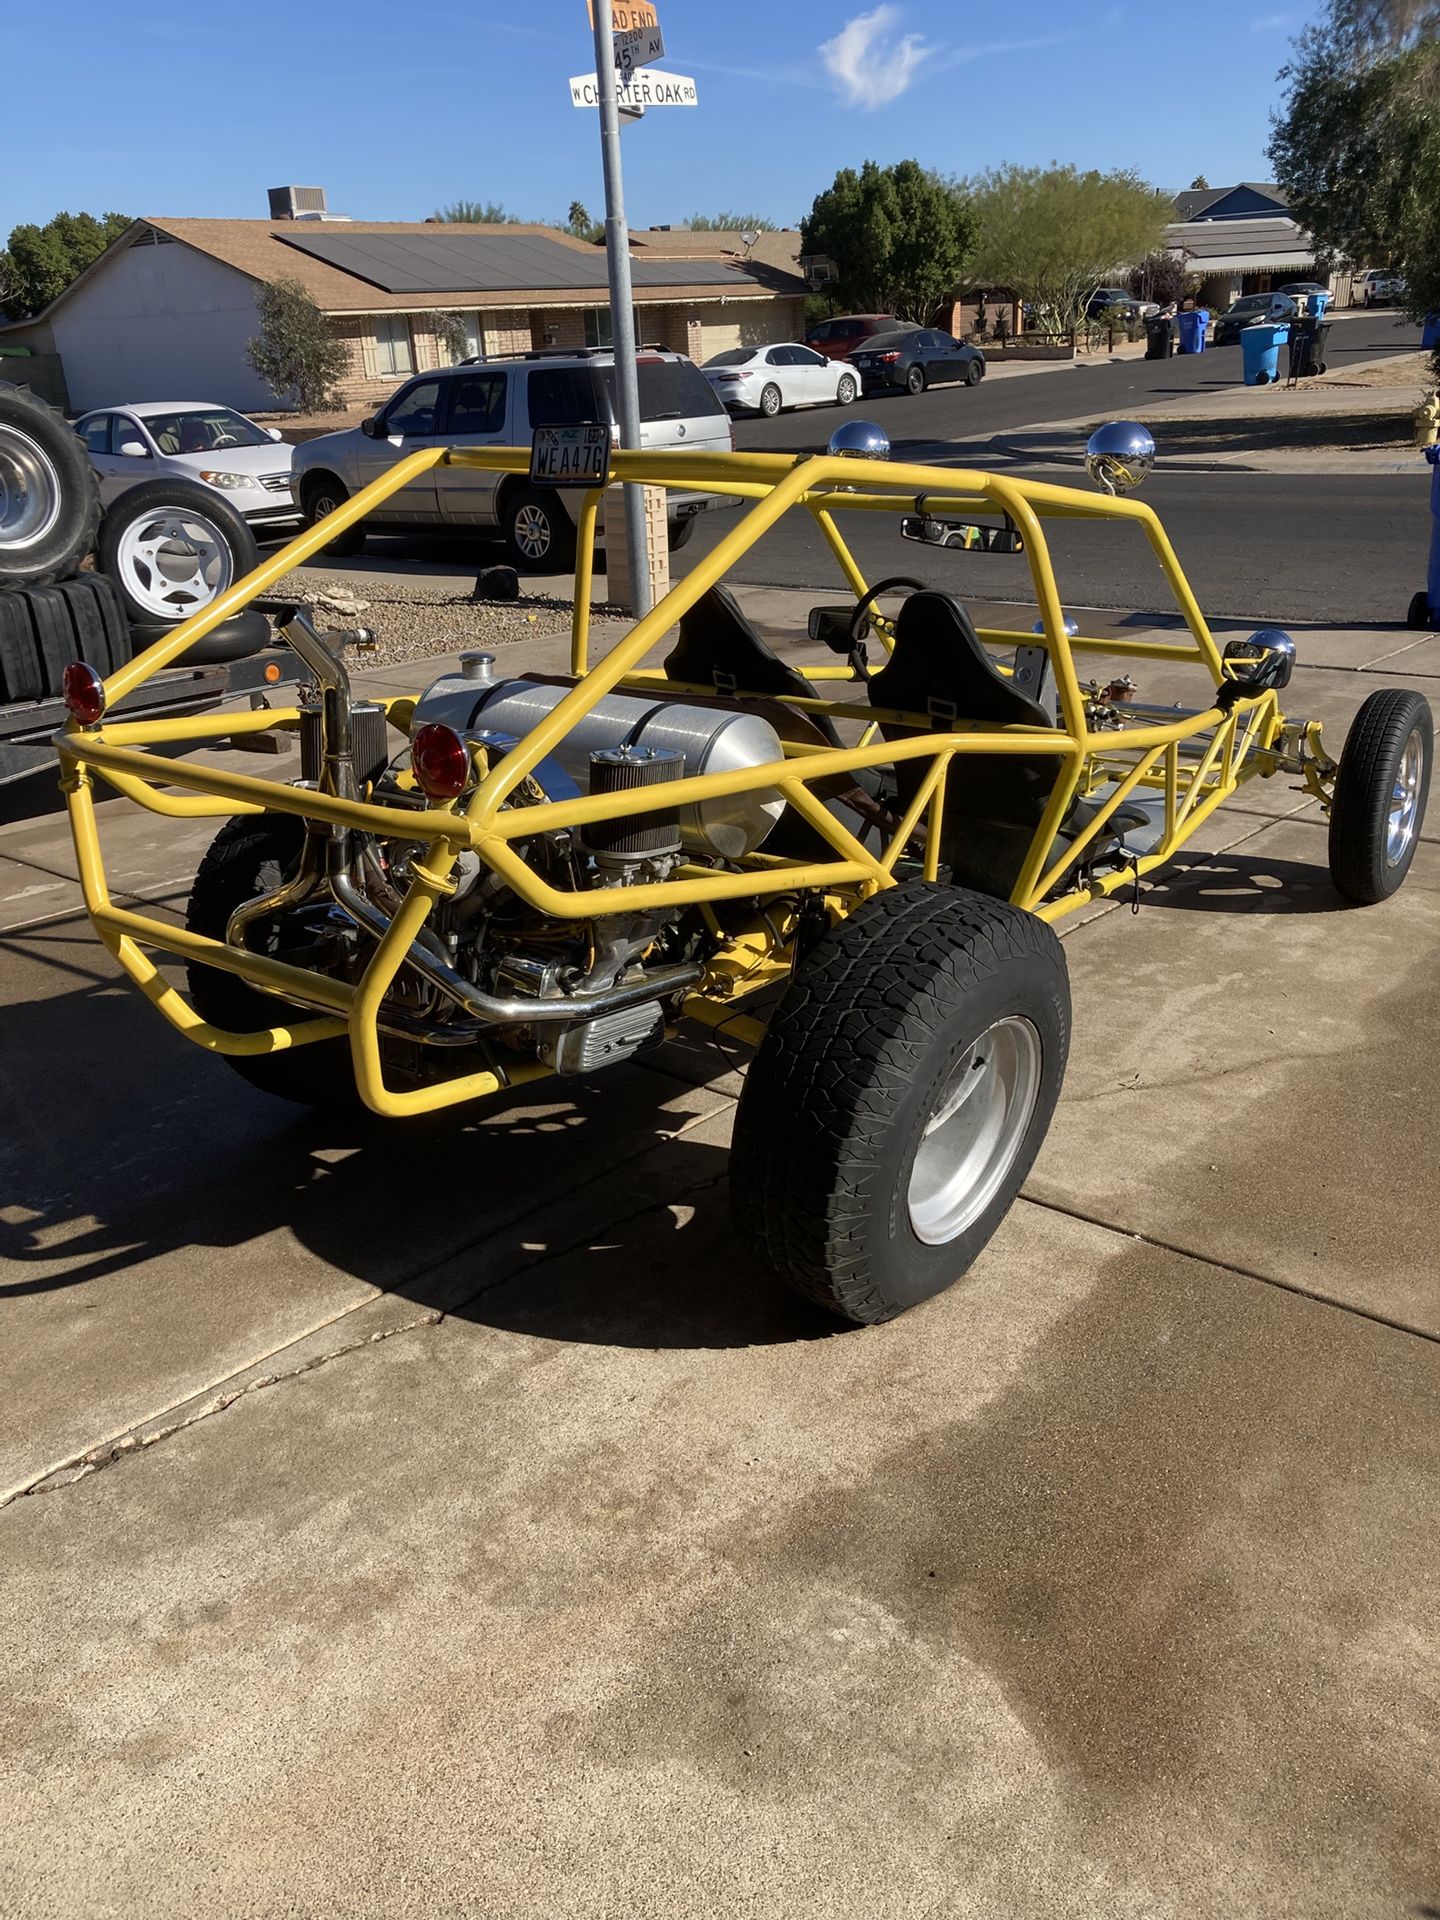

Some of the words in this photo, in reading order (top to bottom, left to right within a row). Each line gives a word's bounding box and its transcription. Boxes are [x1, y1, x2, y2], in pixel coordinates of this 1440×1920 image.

[612, 9, 628, 29] AD
[631, 10, 654, 29] END
[622, 29, 643, 46] 12200
[649, 39, 661, 55] AV
[573, 87, 580, 101] W
[583, 84, 652, 105] CHRTER
[655, 84, 683, 103] OAK
[684, 87, 696, 99] RD
[537, 446, 603, 475] WEA47G
